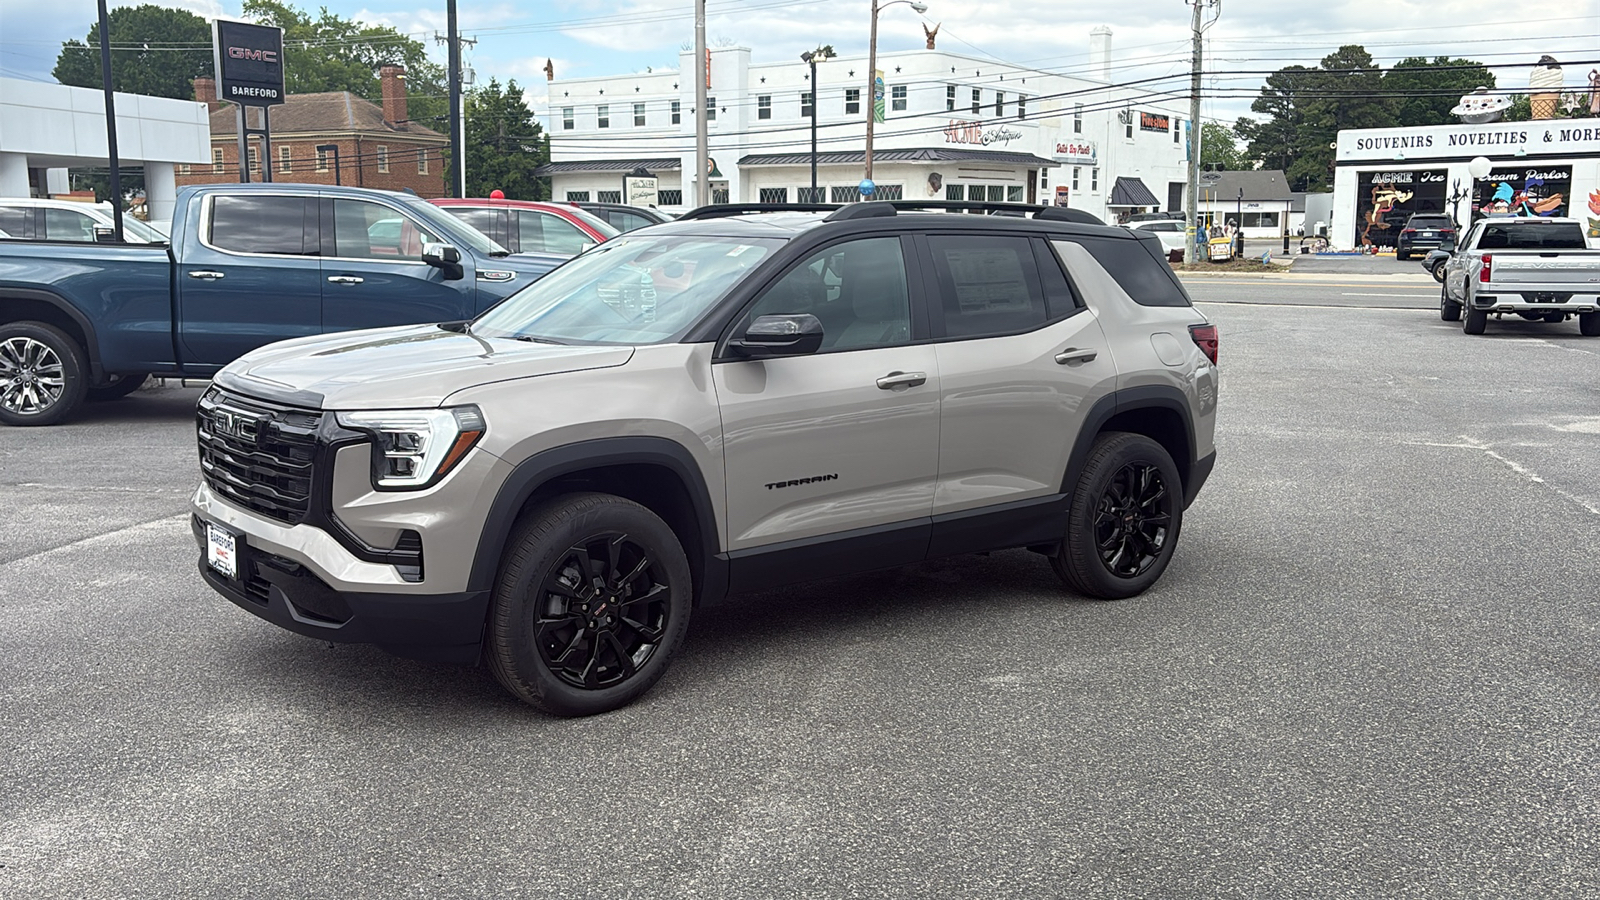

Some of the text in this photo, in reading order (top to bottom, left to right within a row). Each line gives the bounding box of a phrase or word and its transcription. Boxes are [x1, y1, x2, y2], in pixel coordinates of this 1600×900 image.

[229, 47, 276, 62] GMC
[232, 86, 277, 98] BAREFORD
[944, 119, 981, 144] ACME
[1357, 128, 1600, 150] SOUVENIRS NOVELTIES & MORE
[1371, 172, 1413, 184] ACME
[1420, 171, 1446, 183] Ice
[1525, 169, 1569, 181] Parlor
[215, 410, 257, 441] GMC
[764, 473, 838, 490] TERRAIN
[210, 531, 234, 552] BAREFORD
